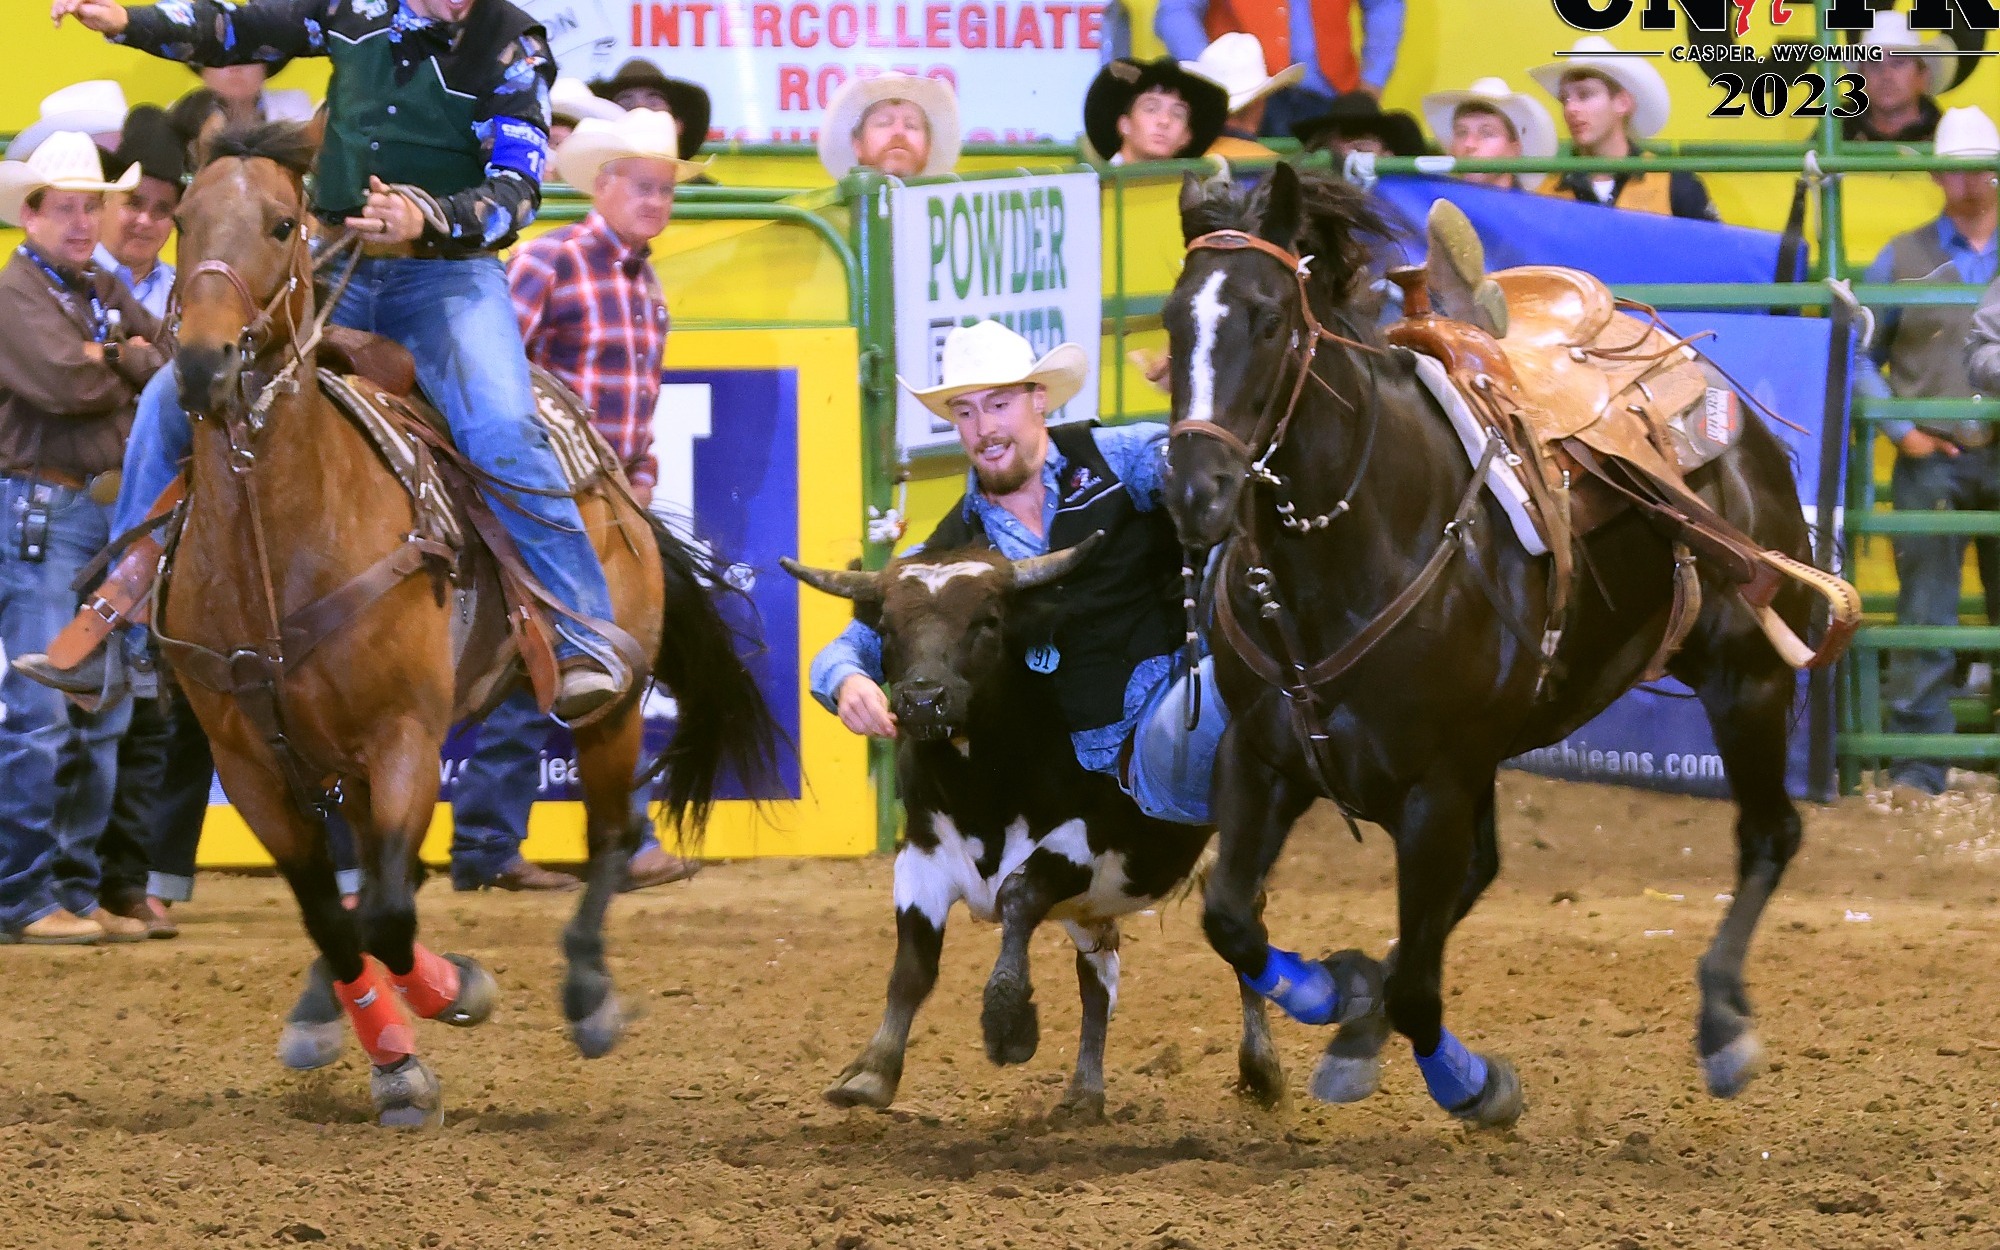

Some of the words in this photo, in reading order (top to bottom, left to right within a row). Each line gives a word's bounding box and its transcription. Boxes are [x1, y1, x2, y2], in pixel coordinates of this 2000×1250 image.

[630, 3, 1103, 49] INTERCOLLEGIATE
[927, 186, 1067, 301] POWDER
[1033, 645, 1051, 670] 91
